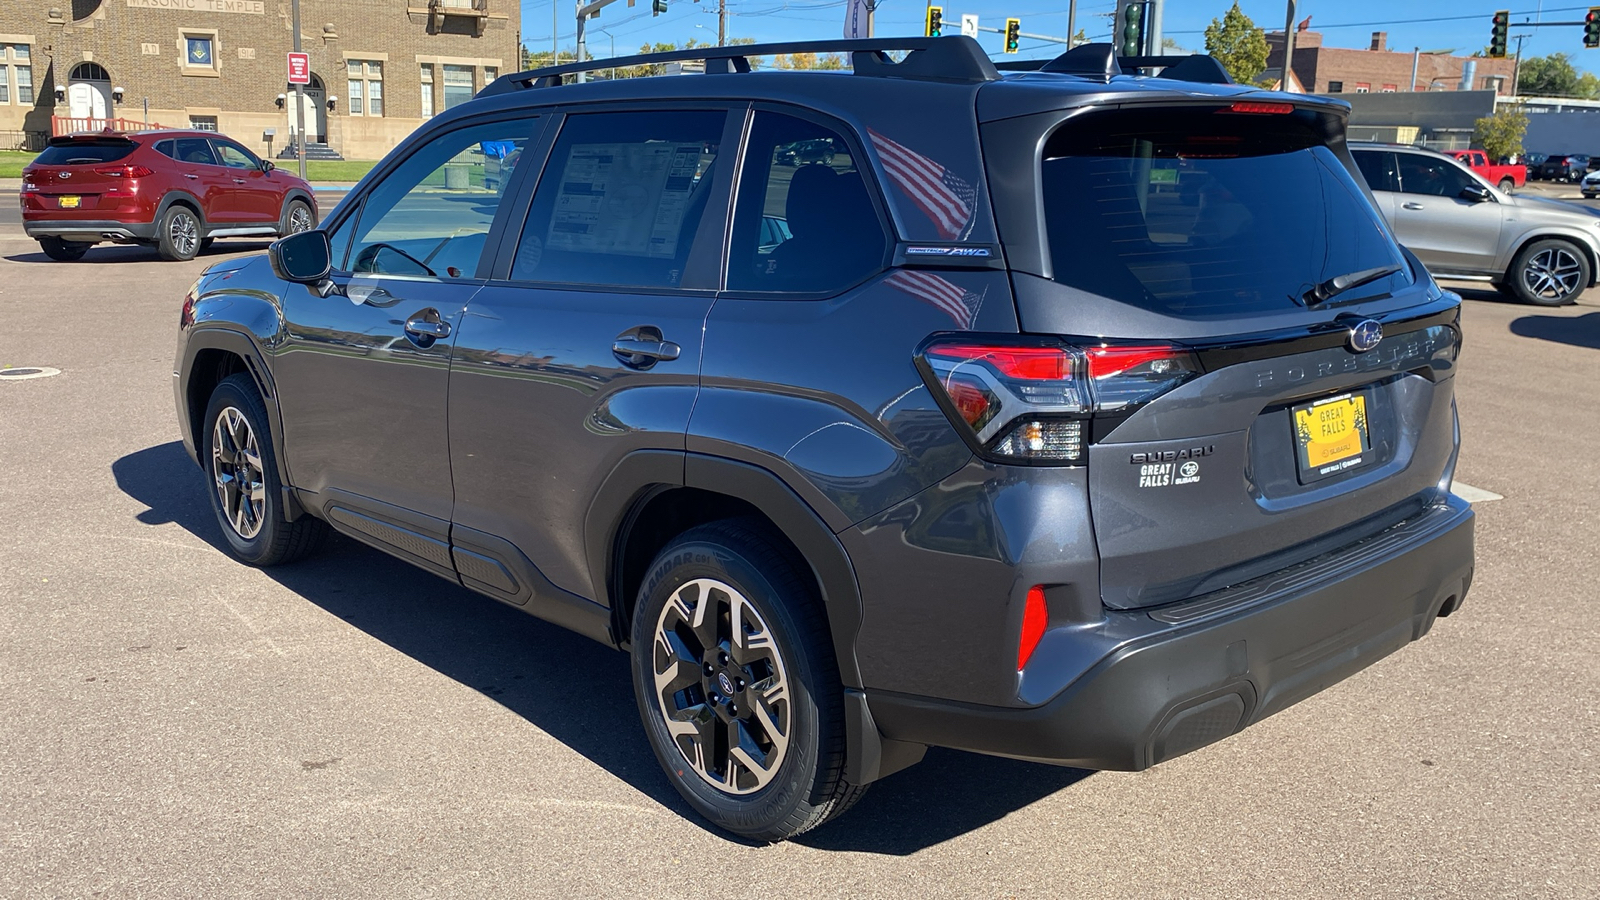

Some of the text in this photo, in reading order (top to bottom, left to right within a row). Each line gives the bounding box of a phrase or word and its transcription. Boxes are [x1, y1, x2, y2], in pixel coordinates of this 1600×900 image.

[129, 0, 262, 12] MASONIC TEMPLE
[1256, 339, 1436, 388] FORESTER
[1320, 406, 1344, 422] GREAT
[1321, 420, 1346, 437] FALLS
[1129, 445, 1215, 464] SUBARU
[1330, 444, 1351, 455] SUBARU
[1141, 463, 1171, 476] GREAT
[1140, 475, 1170, 488] FALLS
[1175, 476, 1200, 485] SUBARU
